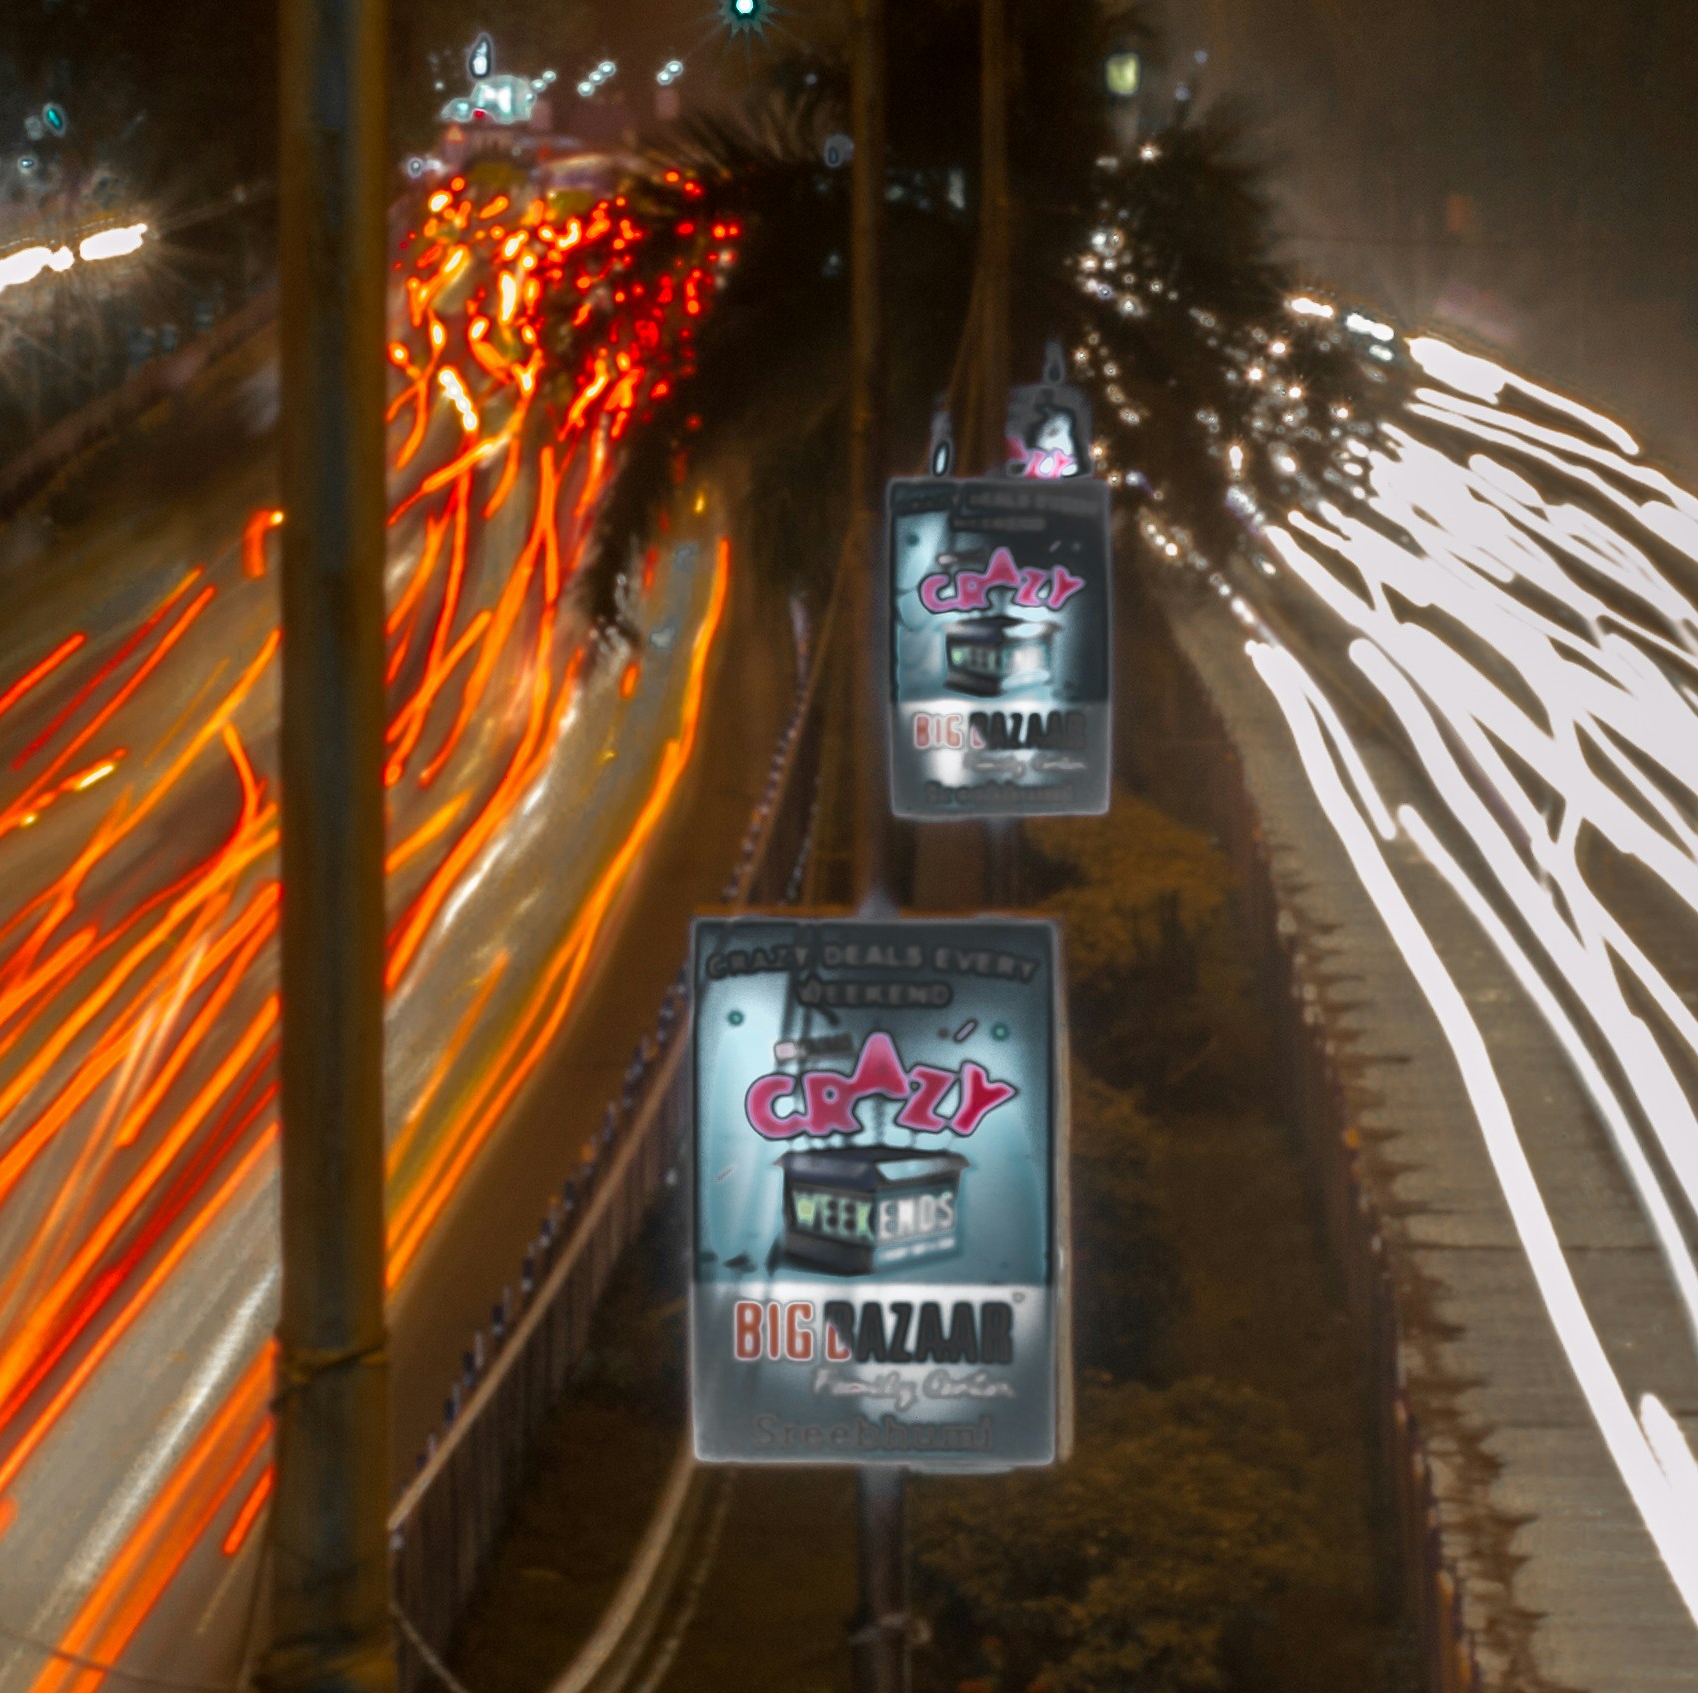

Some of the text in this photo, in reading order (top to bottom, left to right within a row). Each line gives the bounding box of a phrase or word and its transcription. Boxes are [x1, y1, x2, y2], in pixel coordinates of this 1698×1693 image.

[919, 547, 1086, 614] CRAZY
[914, 712, 963, 750] BIG
[706, 943, 1040, 983] CRAZY DEALS EVERY
[744, 1031, 1019, 1140] CRAZY
[733, 1299, 1015, 1364] BIG BAZAAR
[751, 1413, 995, 1451] Sreebhumi
